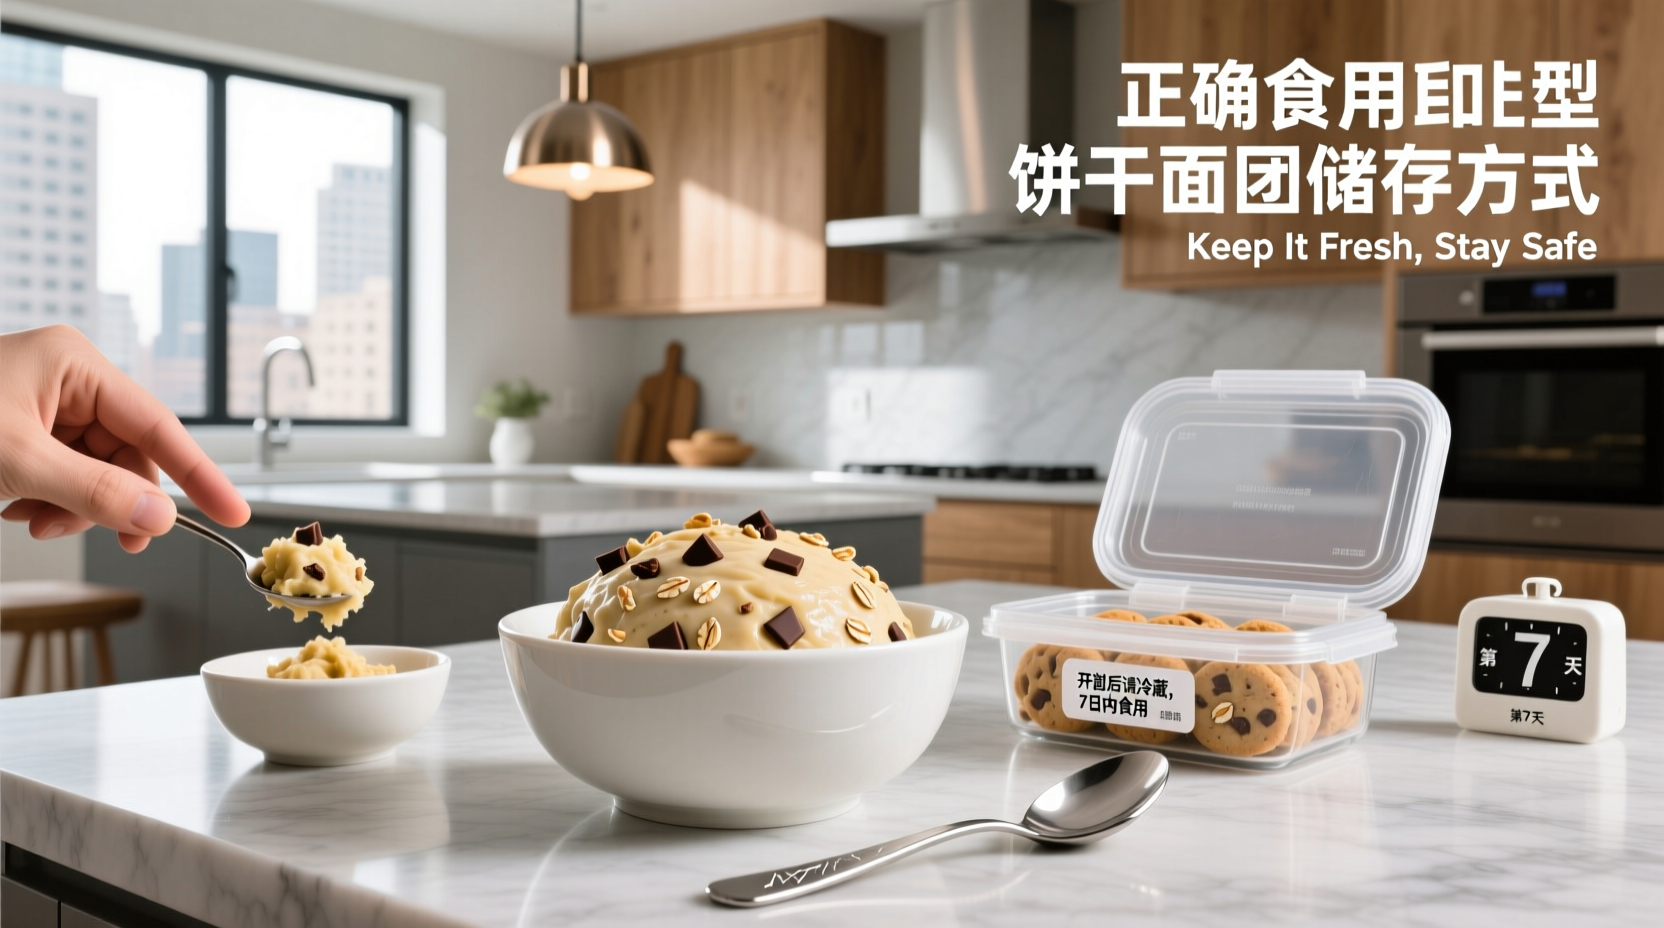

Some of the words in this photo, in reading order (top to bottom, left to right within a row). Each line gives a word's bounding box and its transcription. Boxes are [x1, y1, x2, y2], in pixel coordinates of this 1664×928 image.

[1514, 631, 1551, 688] 7
[1564, 656, 1582, 676] 天
[1510, 708, 1545, 726] 第7天
